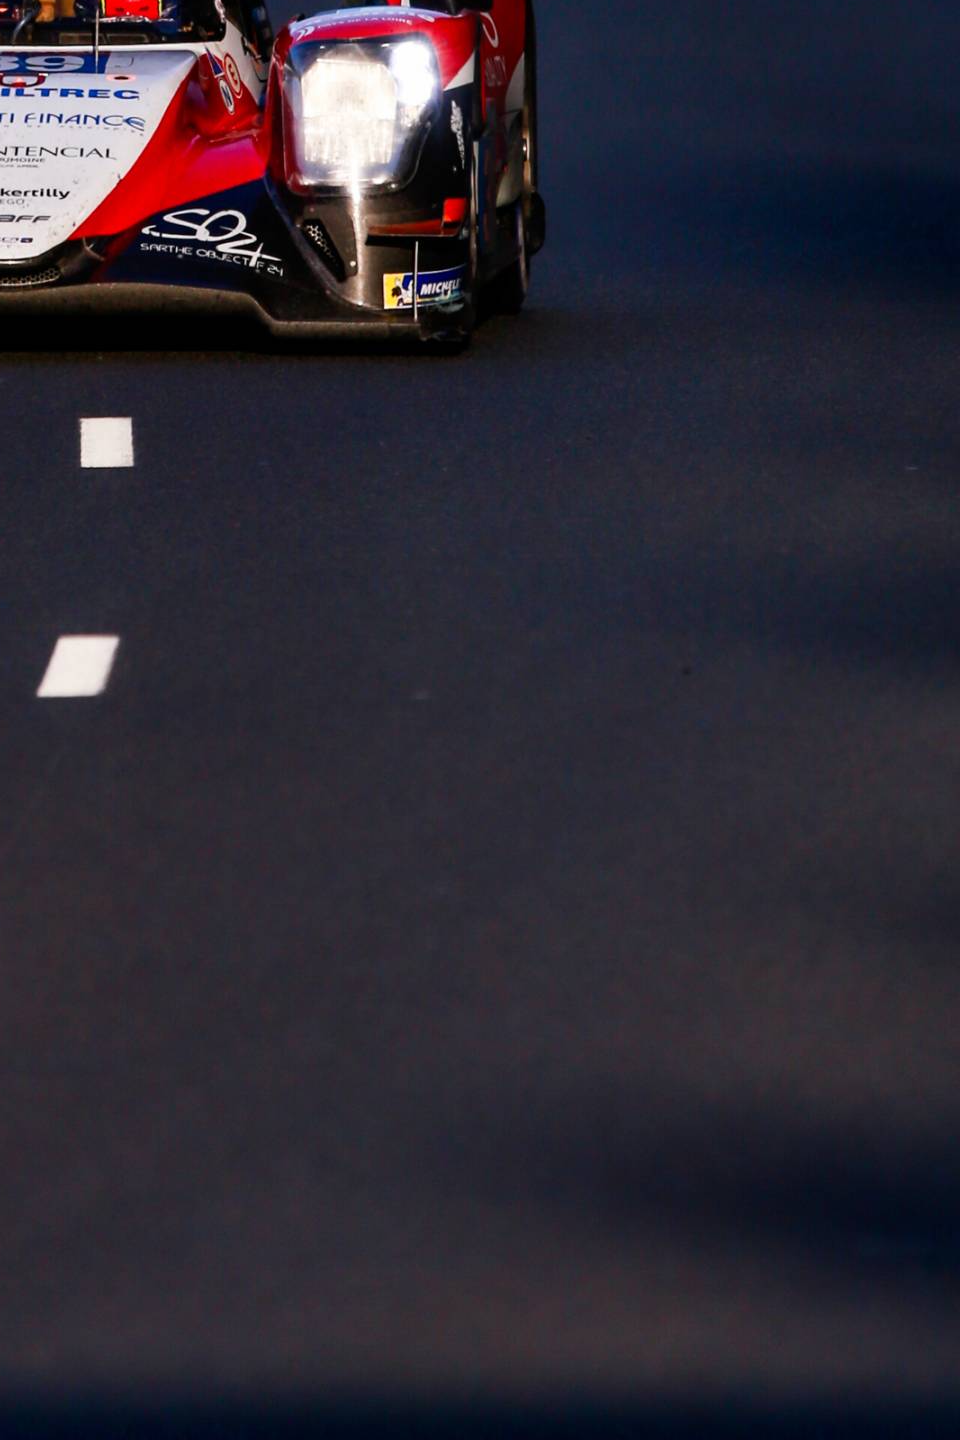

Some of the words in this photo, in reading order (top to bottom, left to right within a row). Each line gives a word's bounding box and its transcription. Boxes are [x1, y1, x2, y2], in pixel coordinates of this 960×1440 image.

[24, 112, 146, 132] FINANCE
[140, 242, 194, 256] SARTHE
[267, 263, 284, 277] 24
